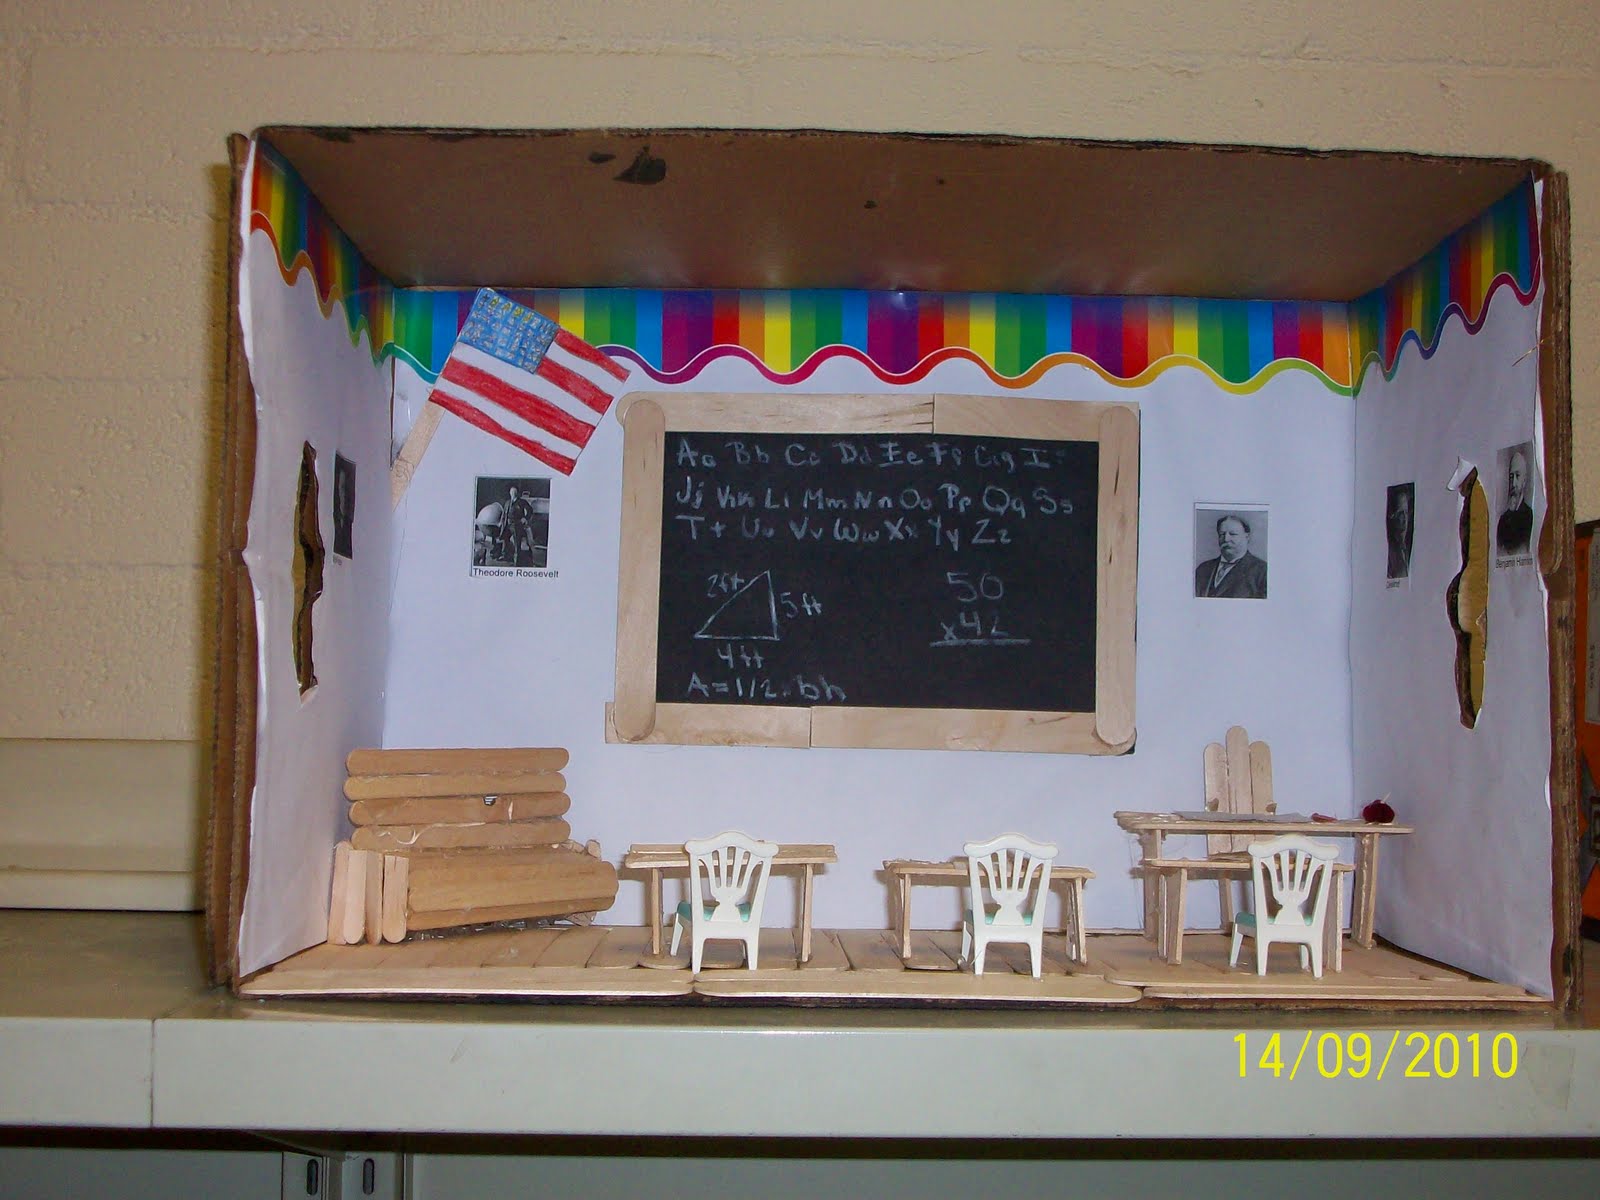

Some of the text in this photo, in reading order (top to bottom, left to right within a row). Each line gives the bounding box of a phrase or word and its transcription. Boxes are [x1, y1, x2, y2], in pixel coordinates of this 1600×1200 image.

[473, 567, 559, 578] Theodore Roosevelt
[946, 570, 1004, 602] 50
